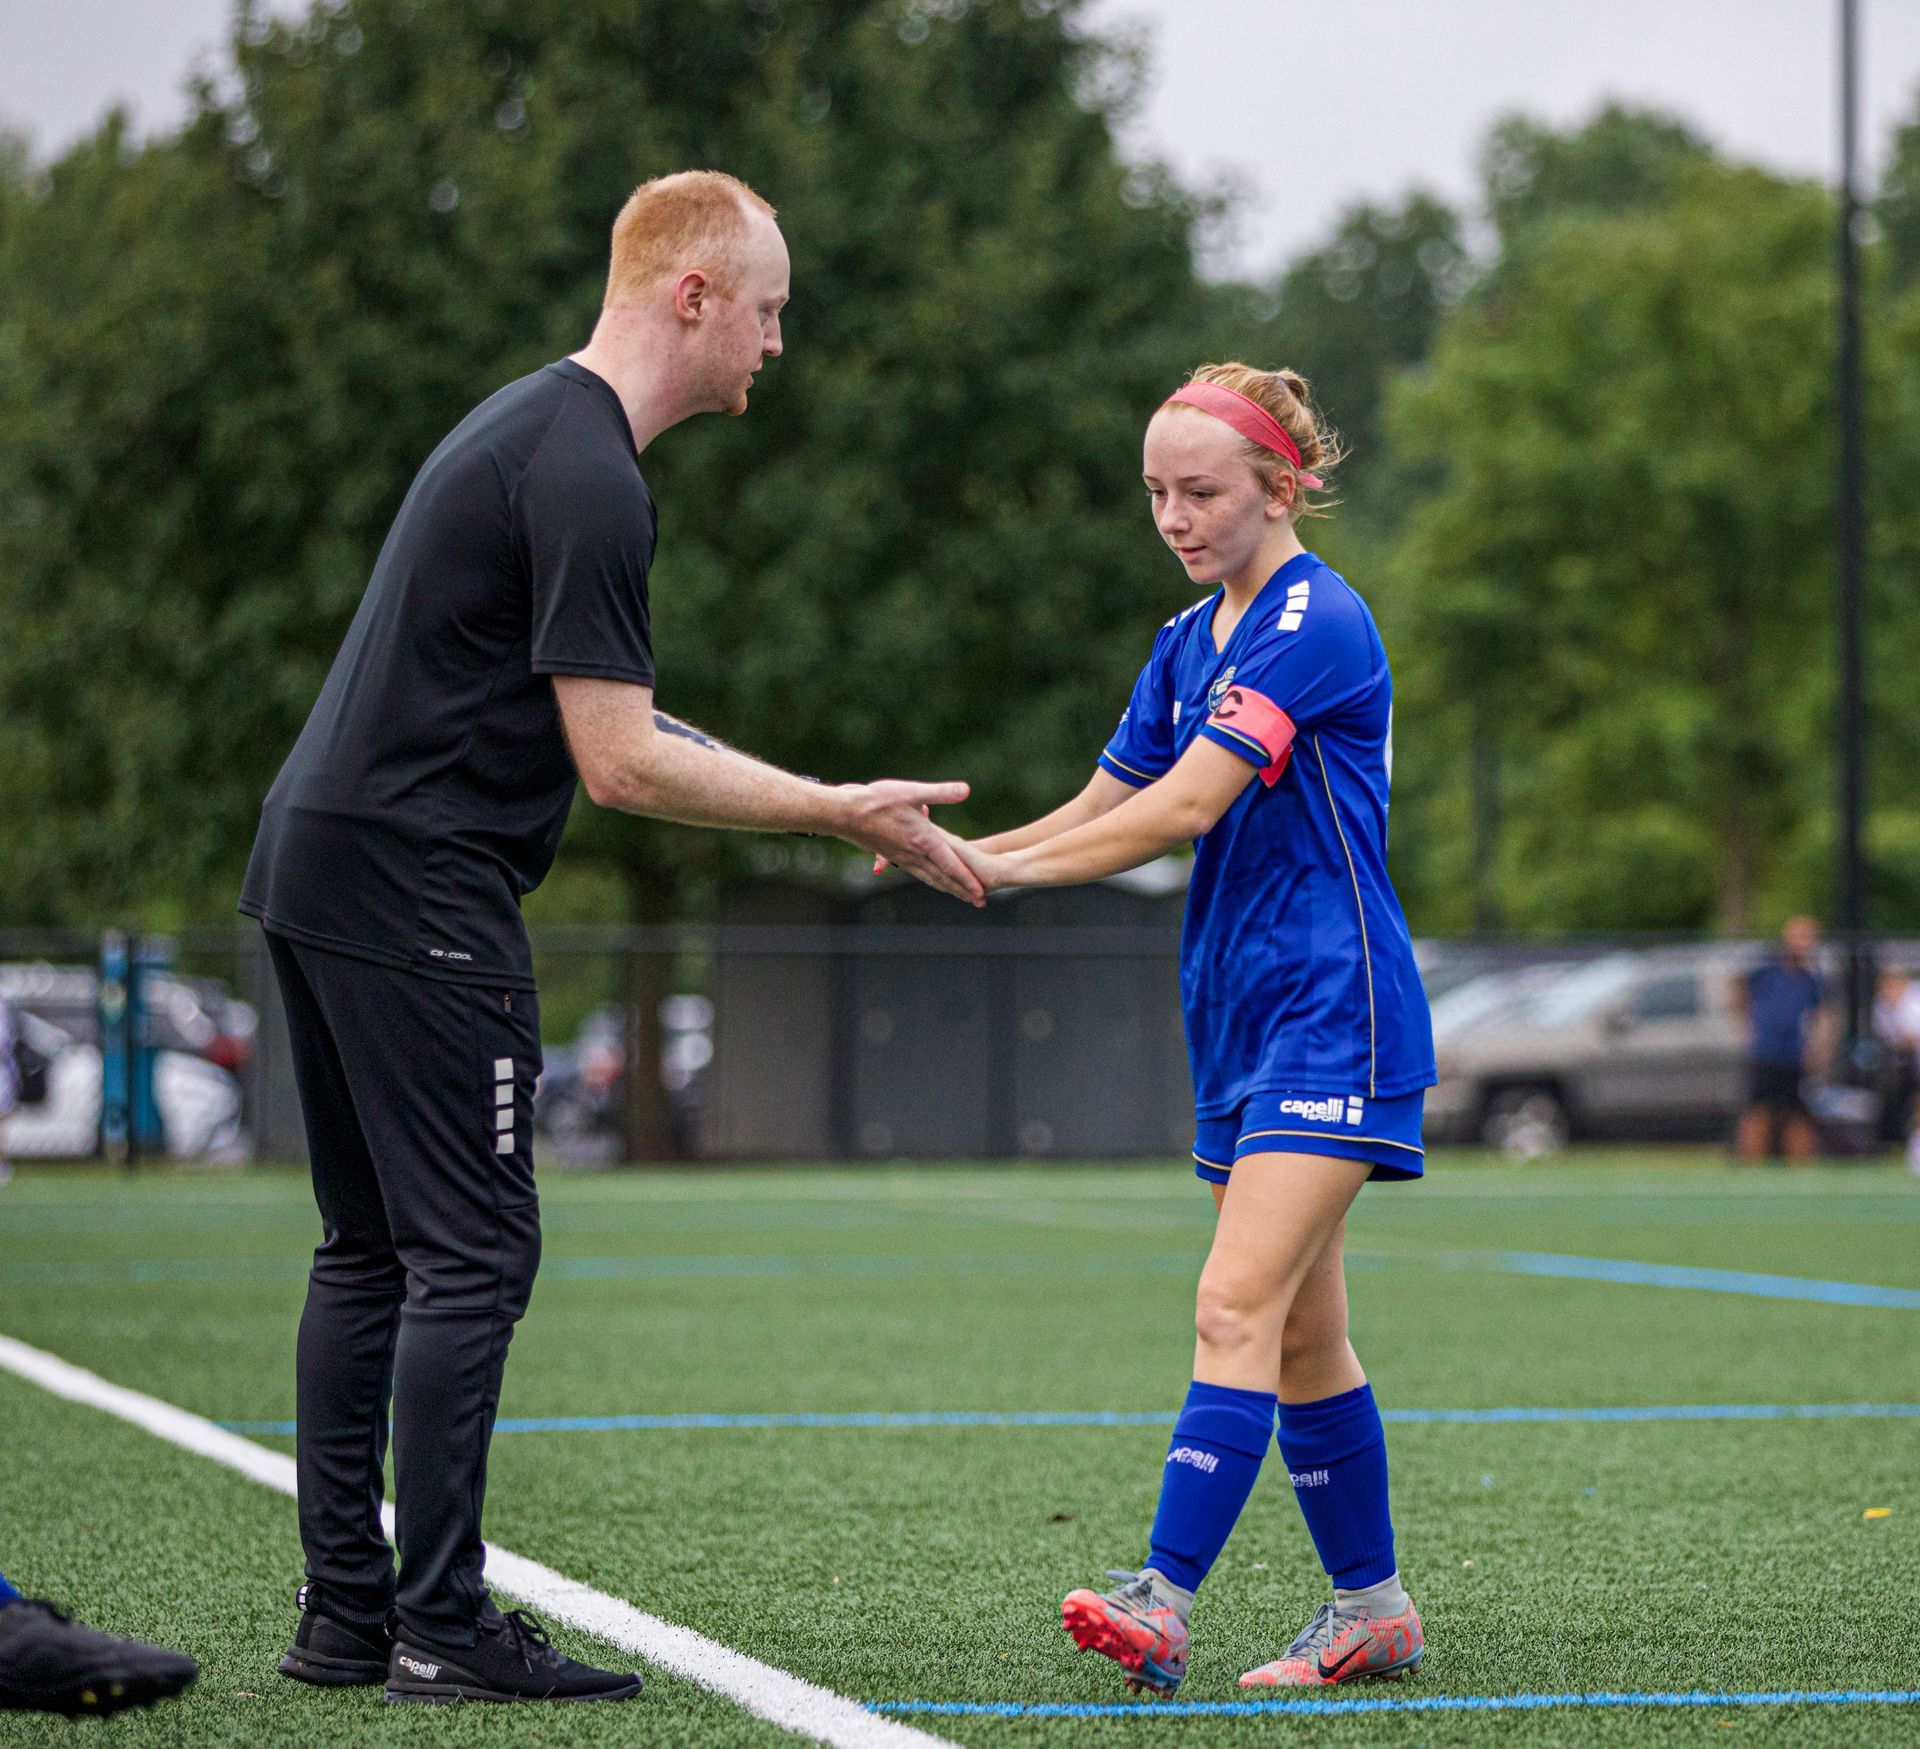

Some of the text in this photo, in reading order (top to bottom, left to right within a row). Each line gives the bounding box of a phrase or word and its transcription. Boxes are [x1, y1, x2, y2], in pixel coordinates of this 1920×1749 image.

[1214, 690, 1243, 719] C
[1280, 1098, 1344, 1119] capelli
[1308, 1113, 1341, 1123] SPORT
[399, 1656, 439, 1677] capelli
